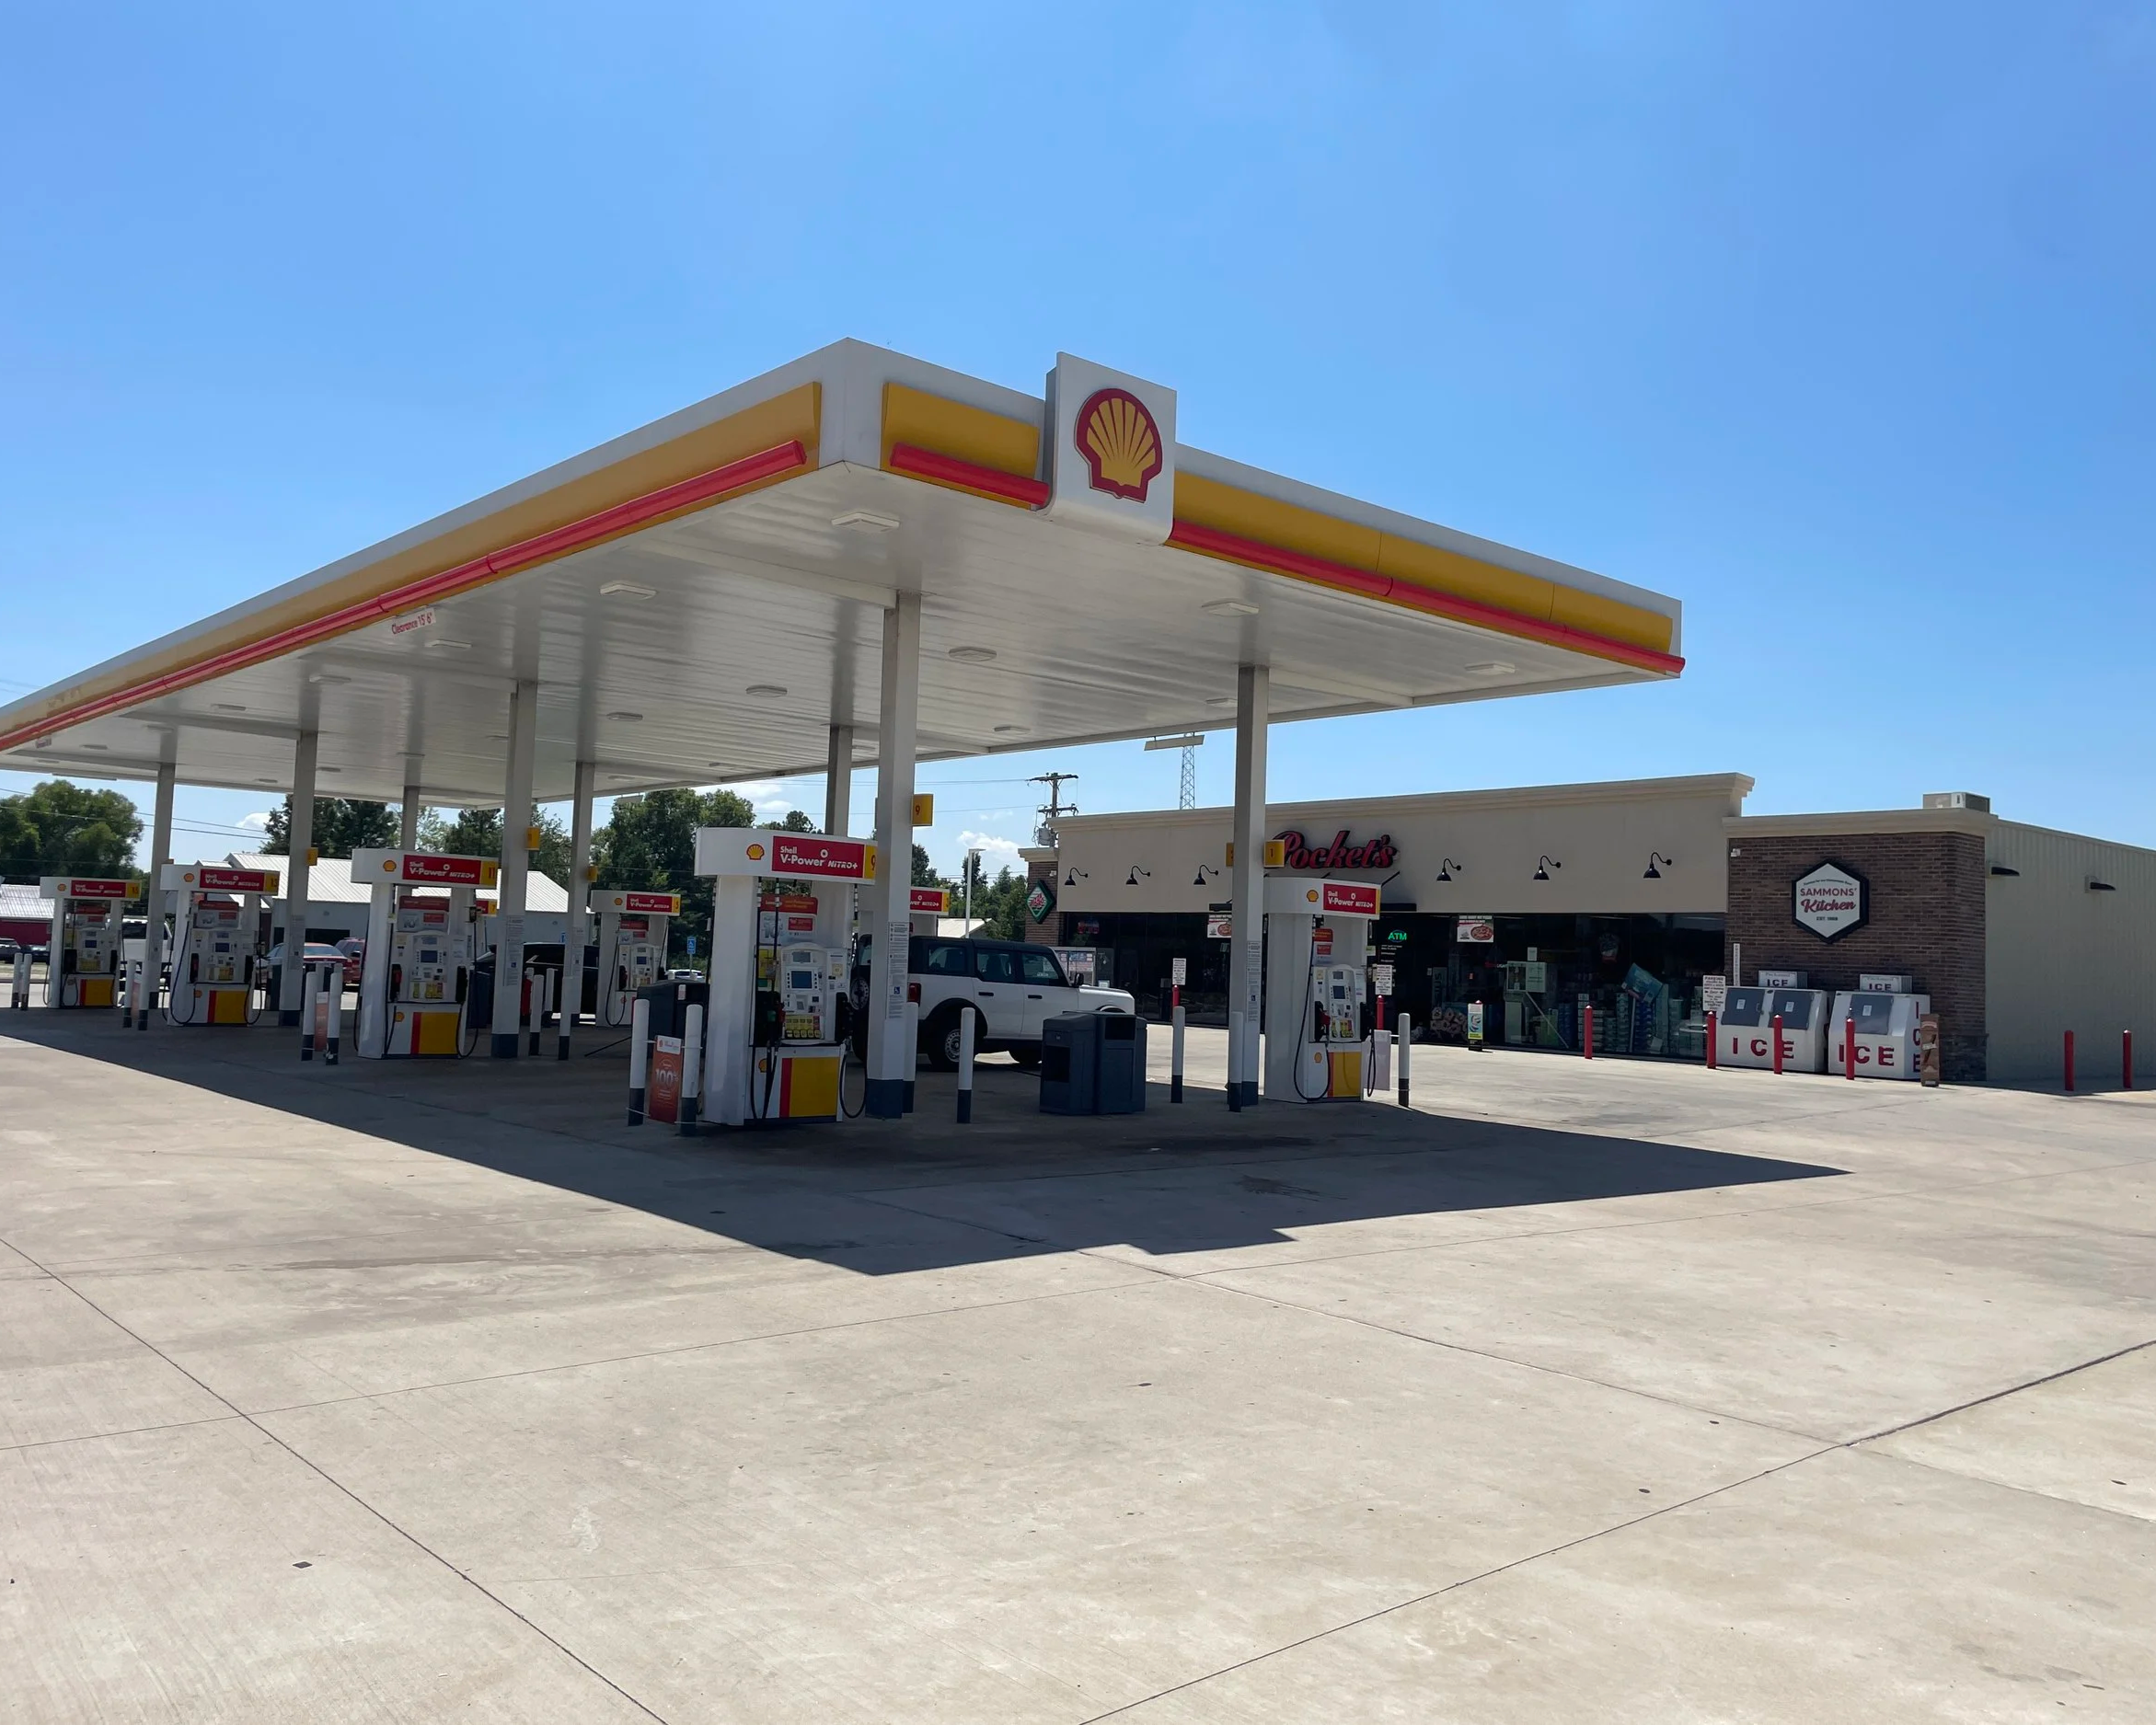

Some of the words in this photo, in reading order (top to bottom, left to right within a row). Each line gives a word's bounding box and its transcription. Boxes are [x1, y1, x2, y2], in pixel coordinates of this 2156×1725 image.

[916, 805, 920, 815] 9
[780, 854, 824, 867] V-Power
[827, 860, 858, 869] NITRO+
[409, 868, 447, 877] V-Power
[1800, 888, 1857, 896] SAMMONS'
[1328, 897, 1354, 906] V-Power
[1801, 899, 1856, 913] Kitchen
[1388, 932, 1407, 940] ATM
[1869, 983, 1892, 991] ICE
[1732, 1037, 1794, 1060] ICE
[1839, 1044, 1895, 1066] ICE
